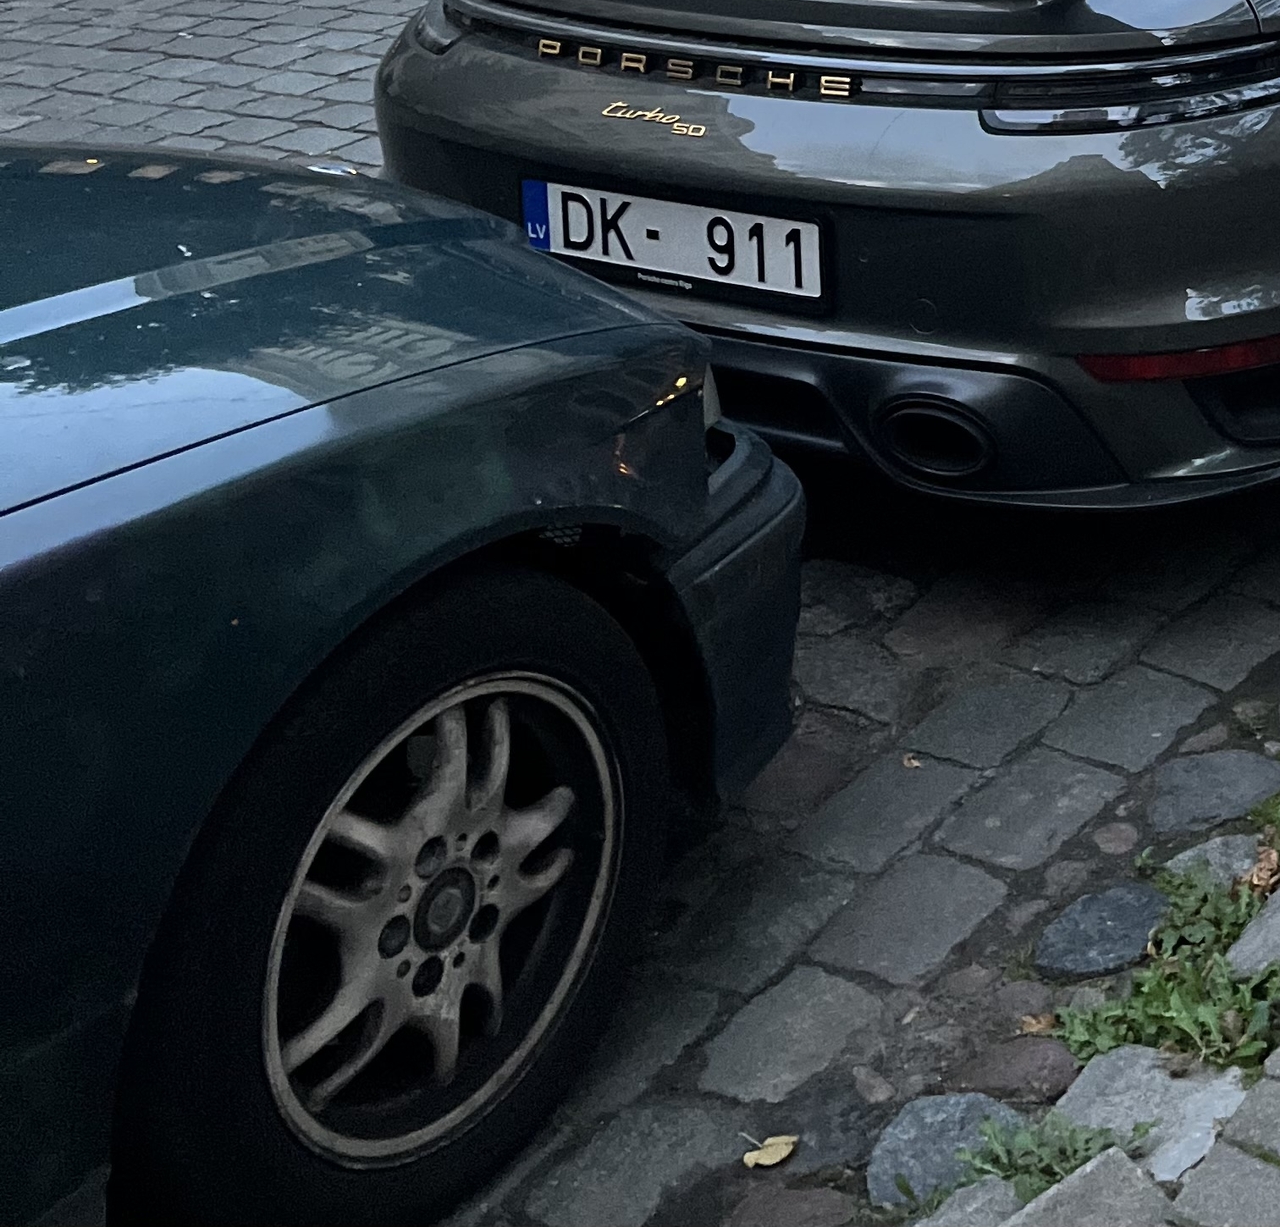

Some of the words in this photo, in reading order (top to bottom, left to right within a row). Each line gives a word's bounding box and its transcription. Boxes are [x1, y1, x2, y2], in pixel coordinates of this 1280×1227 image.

[537, 38, 852, 97] PORSCHE
[601, 100, 681, 125] turbo
[671, 122, 706, 137] 50
[527, 221, 546, 240] LV
[706, 216, 804, 289] 911
